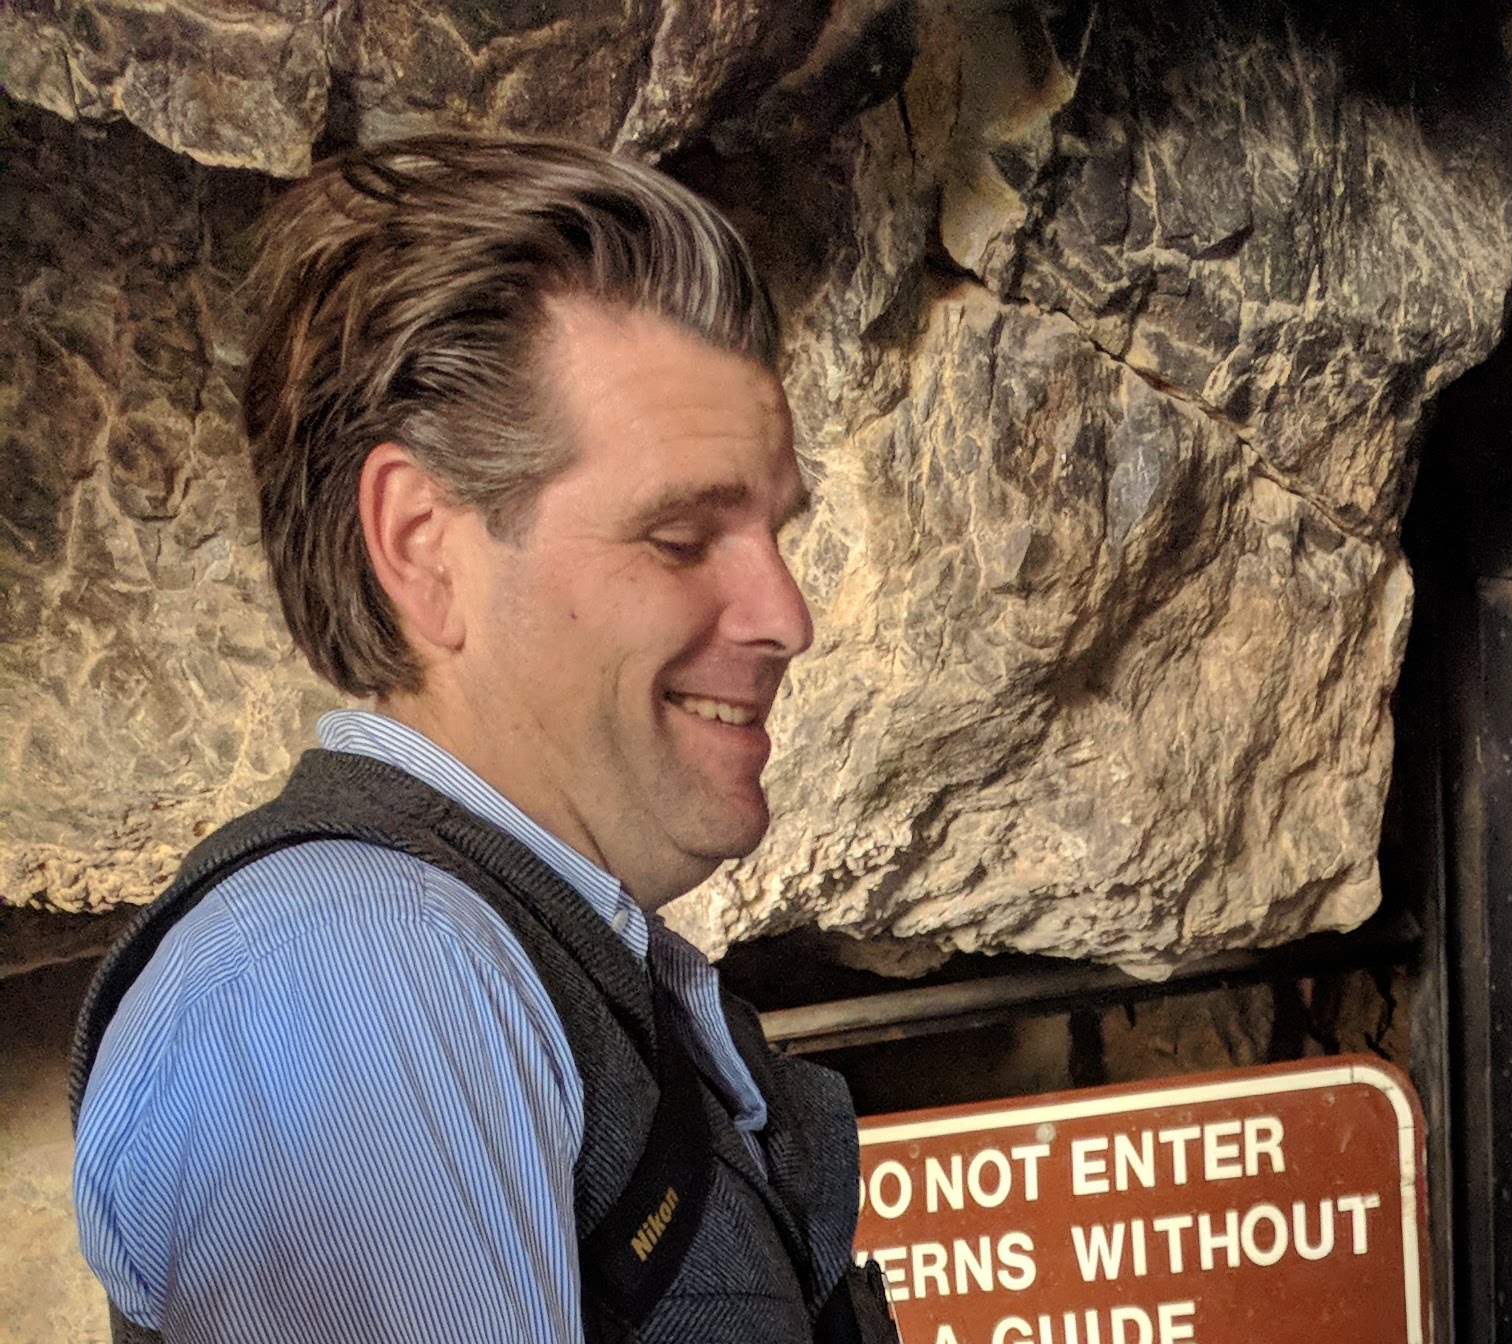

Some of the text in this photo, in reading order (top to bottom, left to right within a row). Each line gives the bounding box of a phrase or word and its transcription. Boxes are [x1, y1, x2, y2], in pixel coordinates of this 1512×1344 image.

[858, 1116, 1285, 1219] O NOT ENTER
[629, 1186, 679, 1263] Nikon
[855, 1193, 1381, 1302] ERNS WITHOUT
